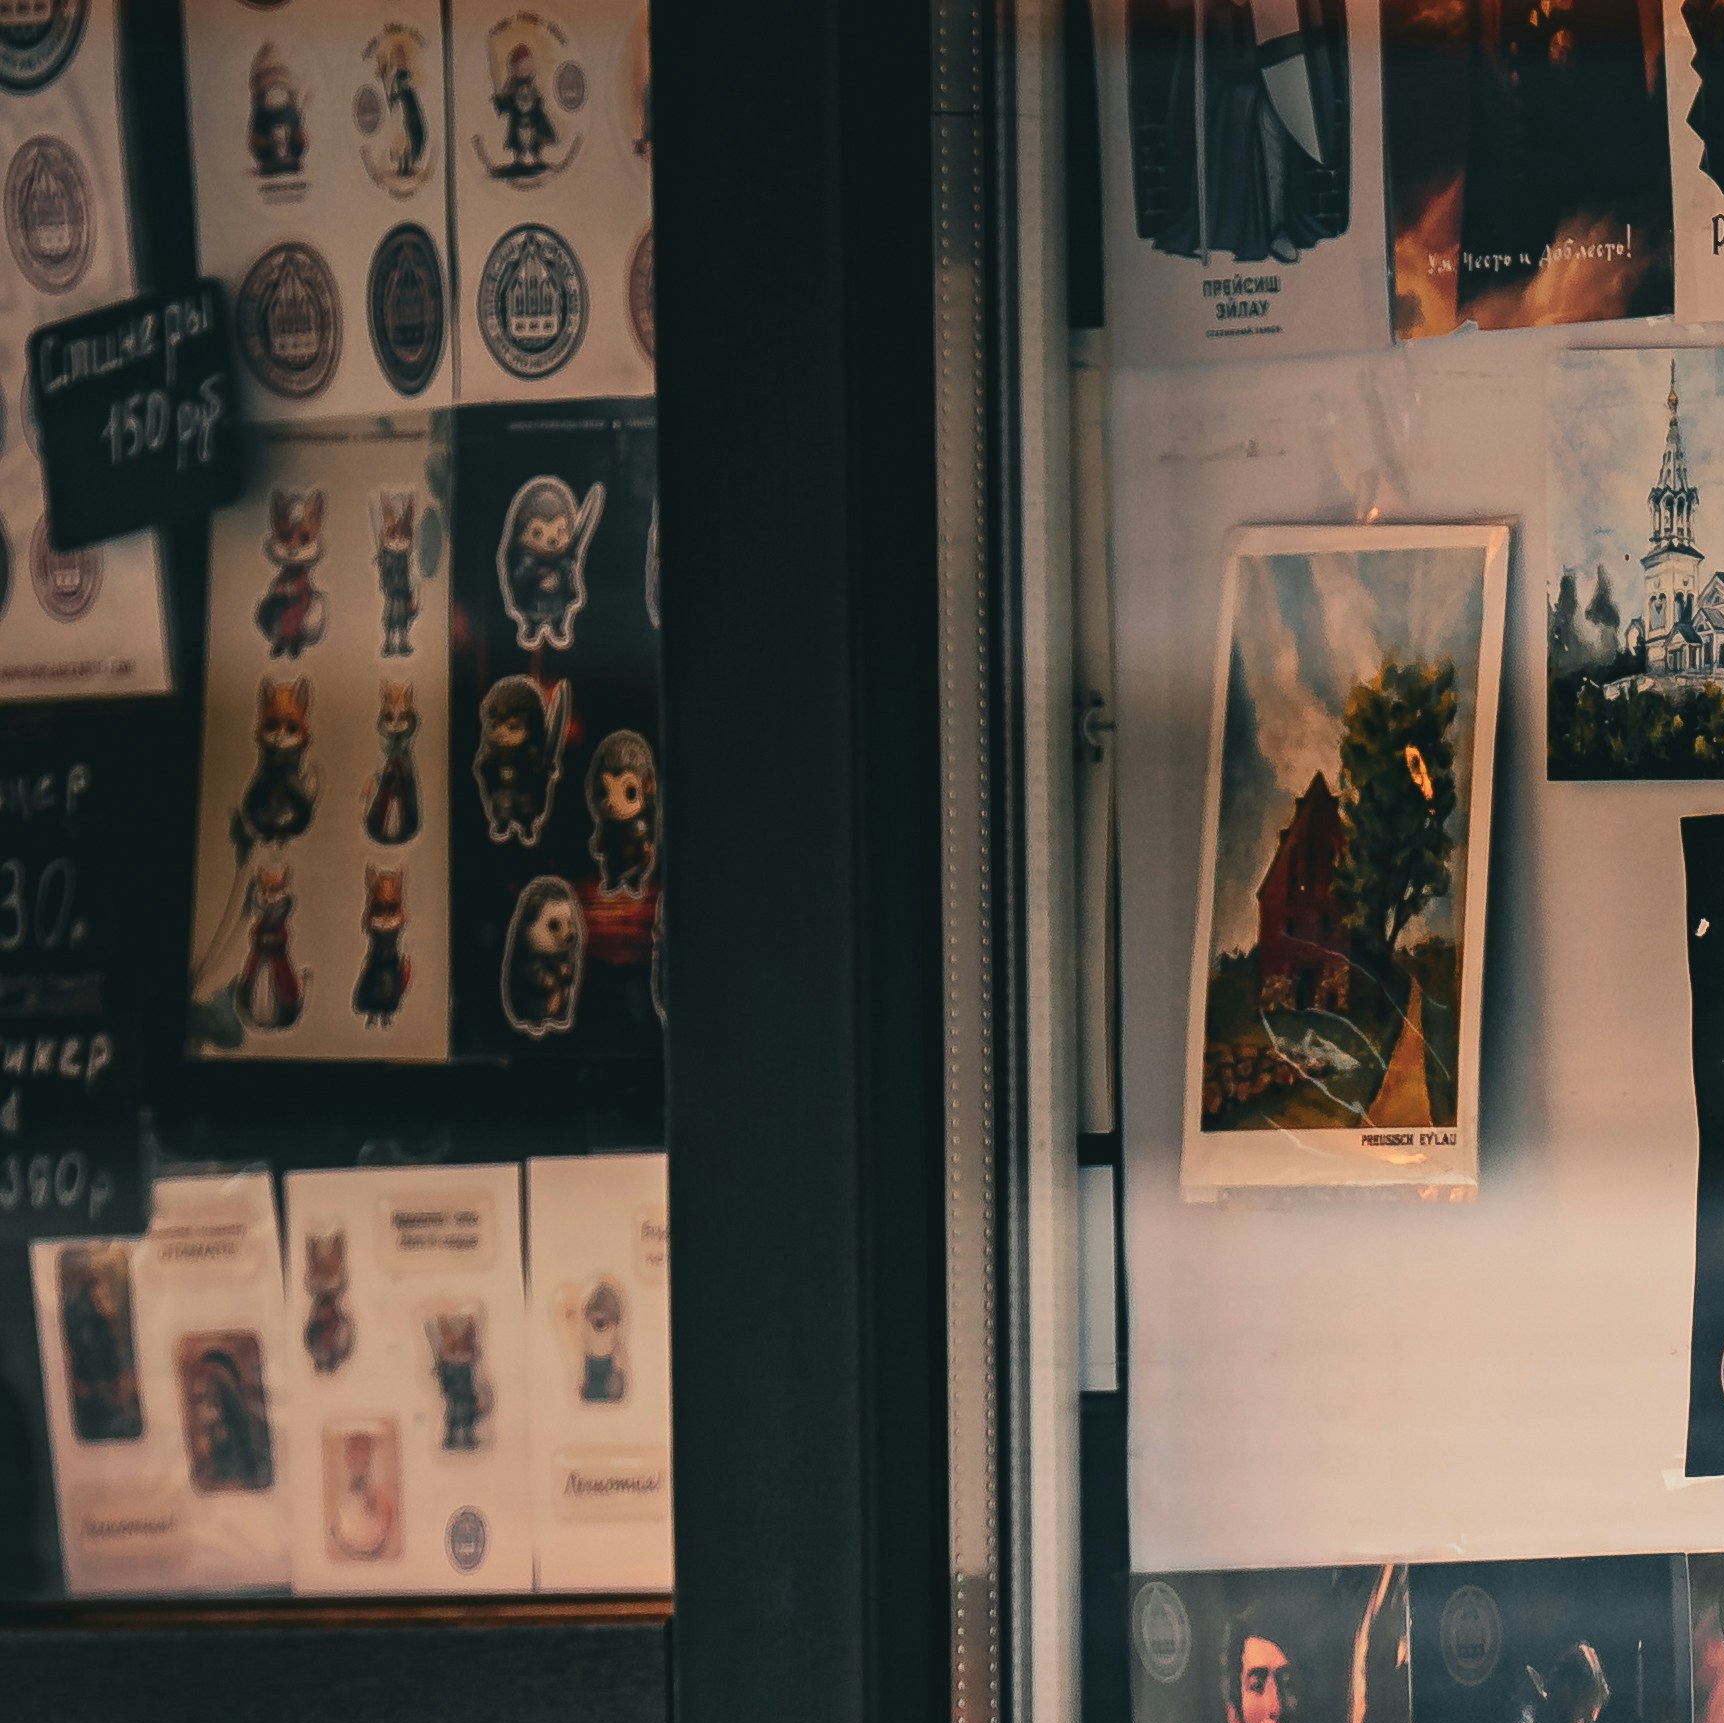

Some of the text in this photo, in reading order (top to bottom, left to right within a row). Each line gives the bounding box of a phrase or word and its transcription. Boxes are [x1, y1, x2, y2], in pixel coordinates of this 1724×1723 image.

[1520, 252, 1531, 265] и
[1203, 274, 1280, 297] ПРЕЙСИШ
[1216, 297, 1268, 320] ЭЙЛАУ
